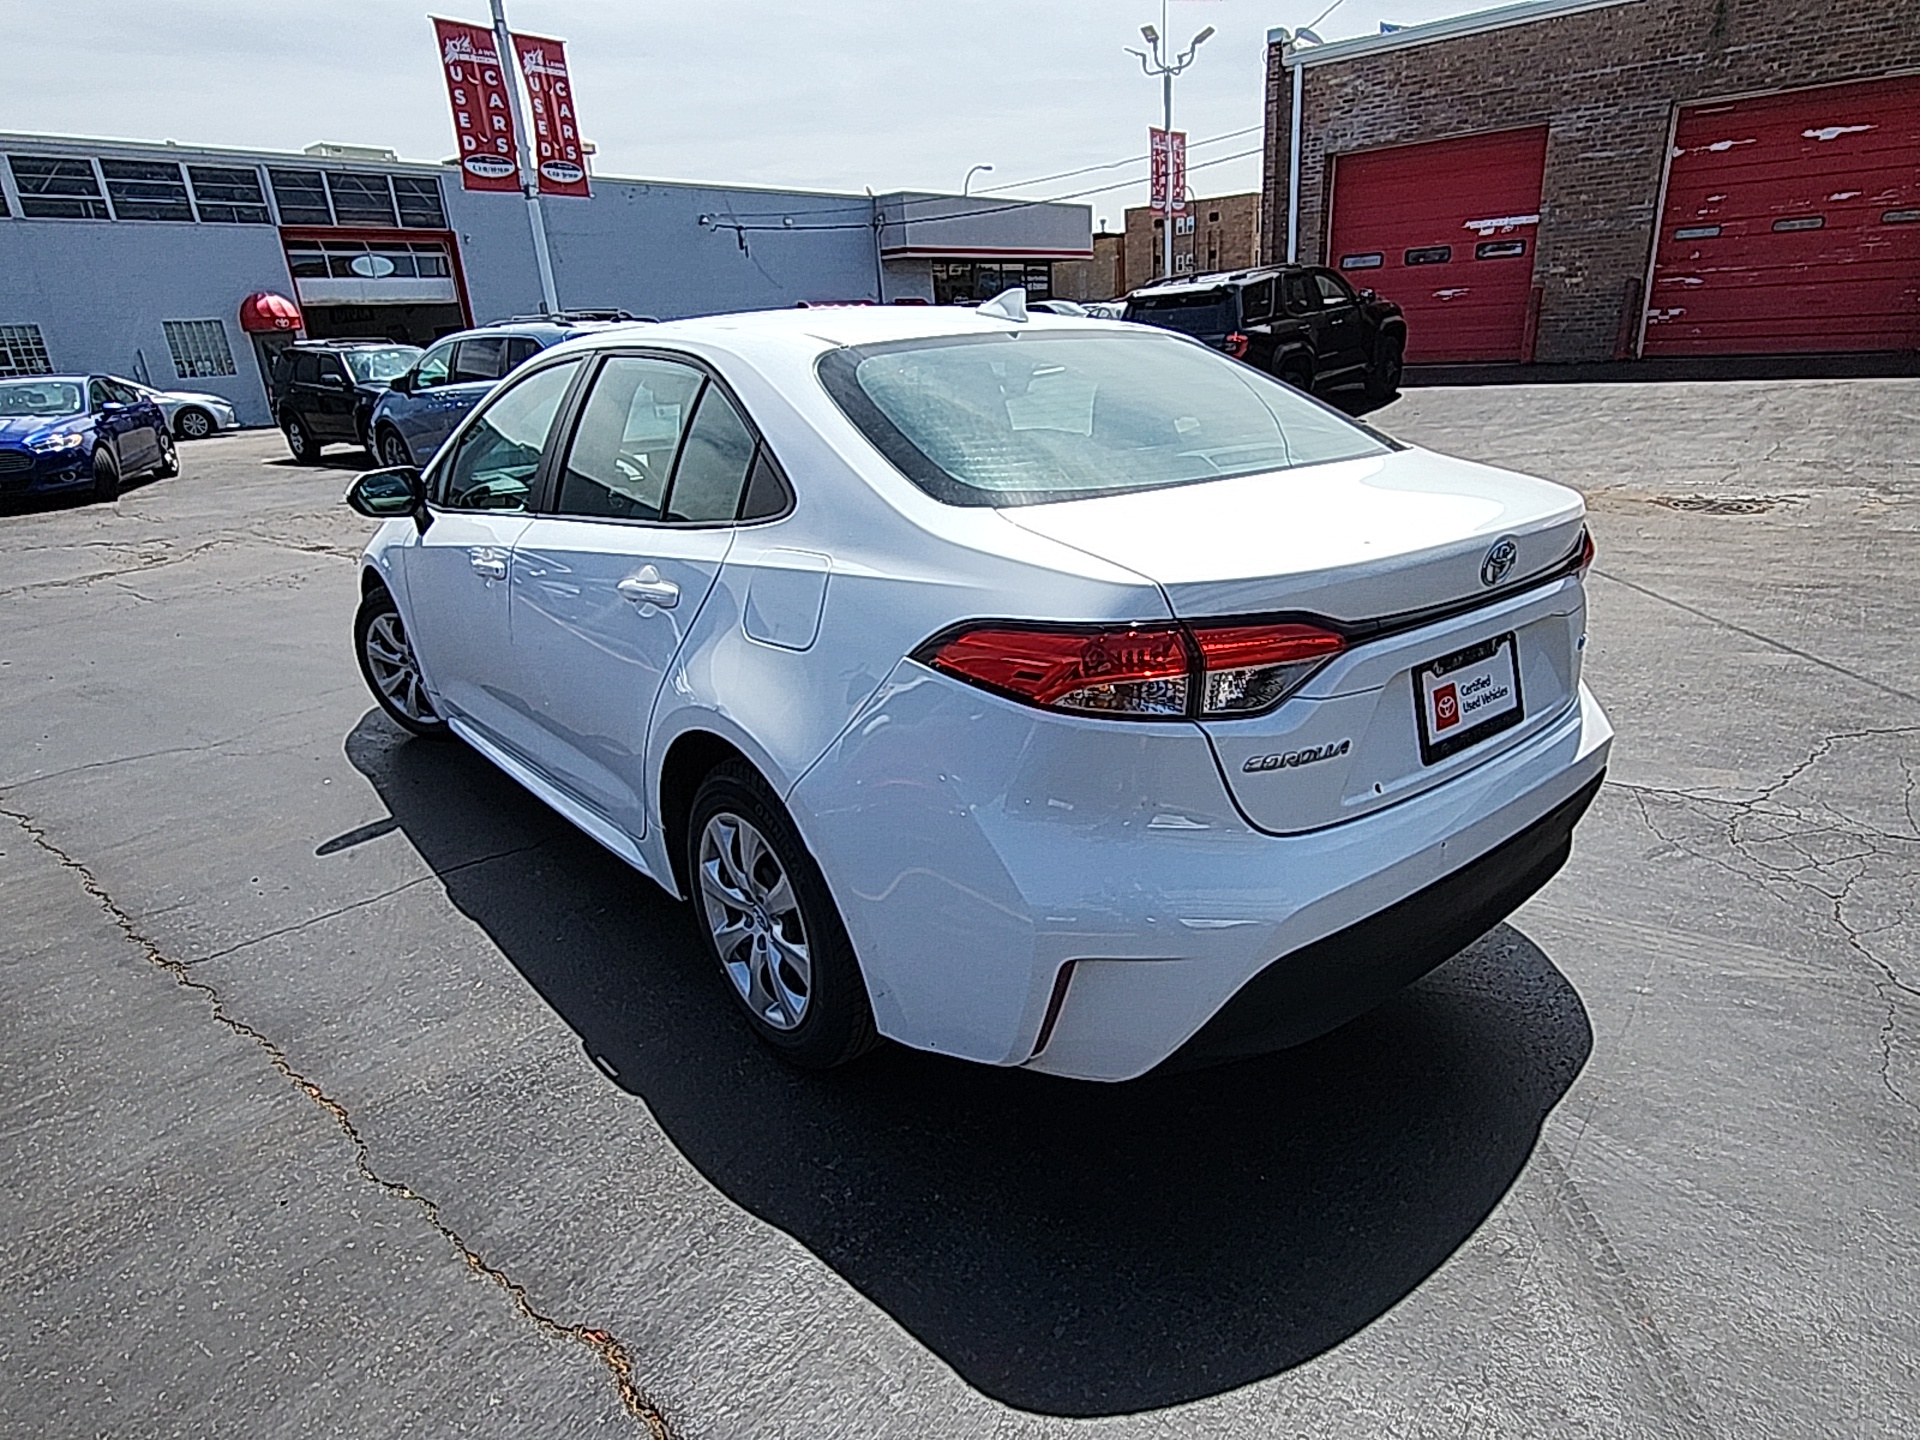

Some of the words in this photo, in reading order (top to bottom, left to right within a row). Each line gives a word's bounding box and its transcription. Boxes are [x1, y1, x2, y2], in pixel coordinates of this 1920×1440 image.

[449, 64, 477, 151] USED
[484, 70, 509, 153] CARS
[529, 76, 552, 157] USED
[555, 81, 577, 160] CARS
[1460, 673, 1491, 696] Certified
[1462, 695, 1481, 713] Used
[1481, 686, 1508, 705] Vehicles
[1241, 739, 1350, 773] COROLLA
